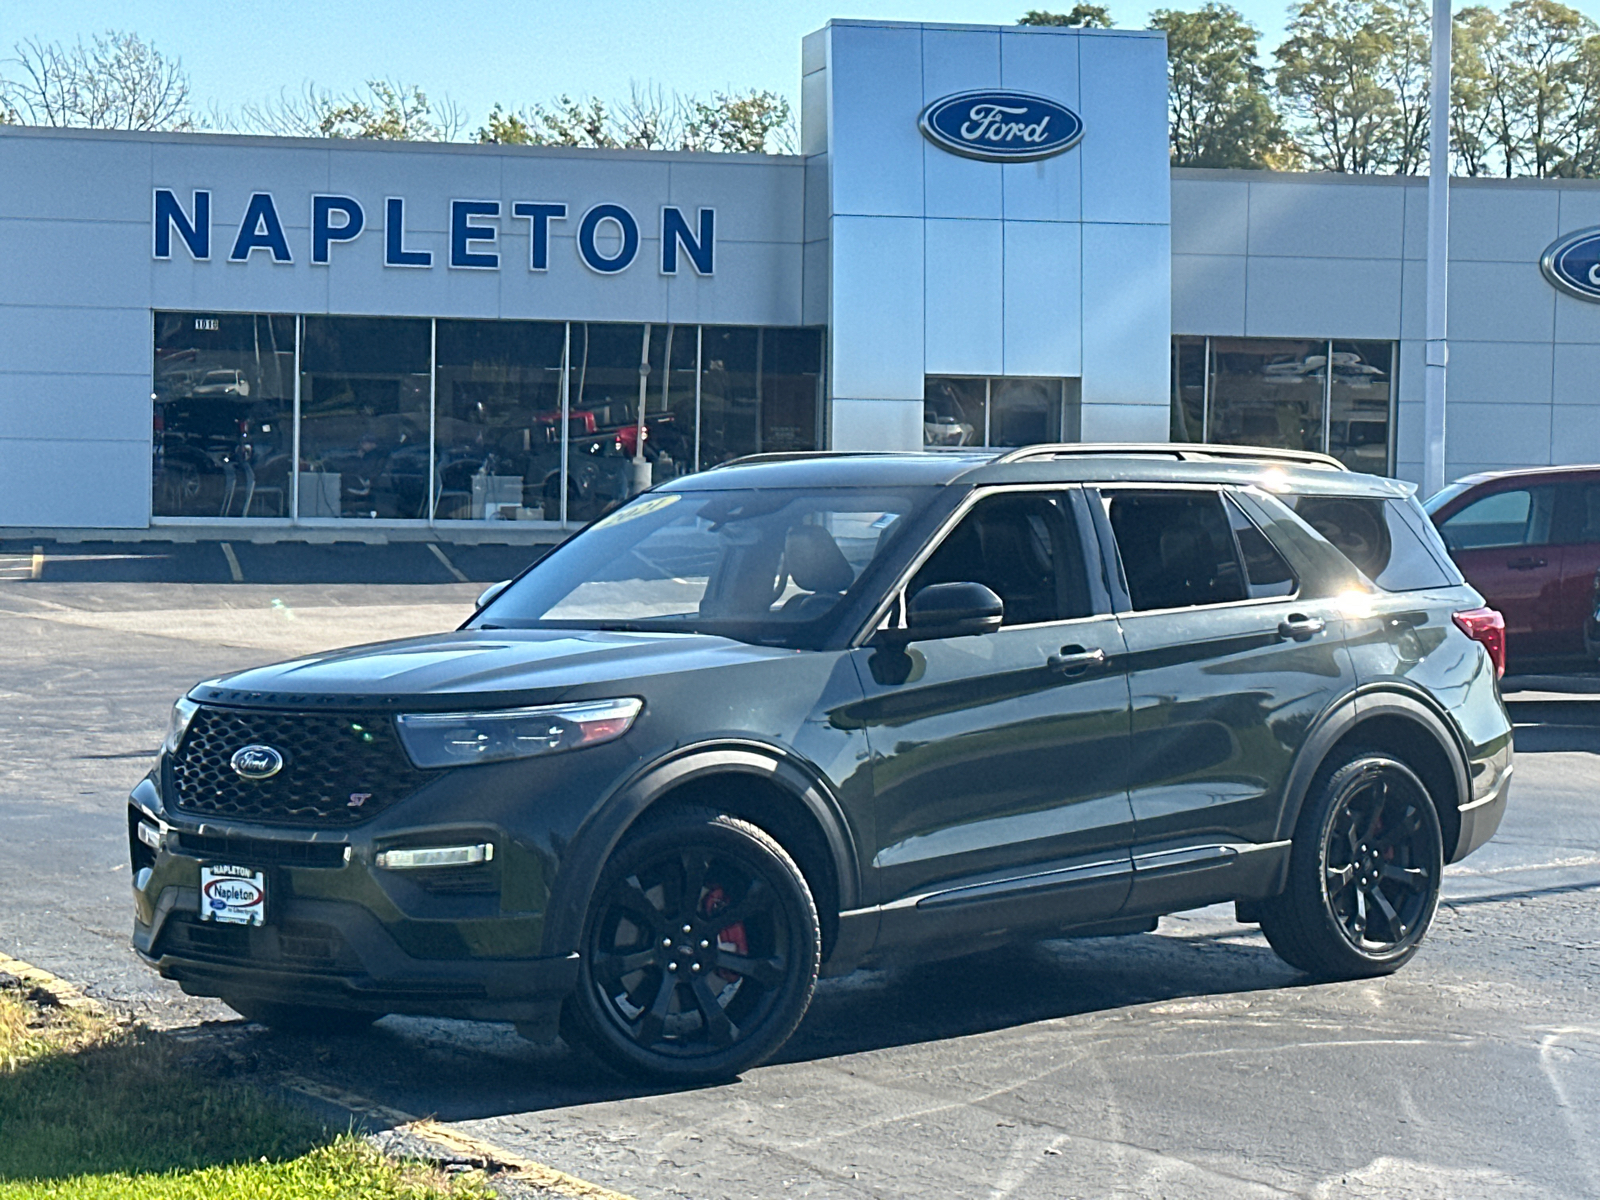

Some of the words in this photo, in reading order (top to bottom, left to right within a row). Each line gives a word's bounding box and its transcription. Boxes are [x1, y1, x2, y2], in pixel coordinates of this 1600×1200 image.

[961, 103, 1051, 143] Ford
[152, 187, 716, 276] NAPLETON
[240, 750, 269, 770] Ford
[346, 792, 372, 807] ST
[213, 865, 251, 877] NAPLETON
[214, 884, 254, 901] Napleton
